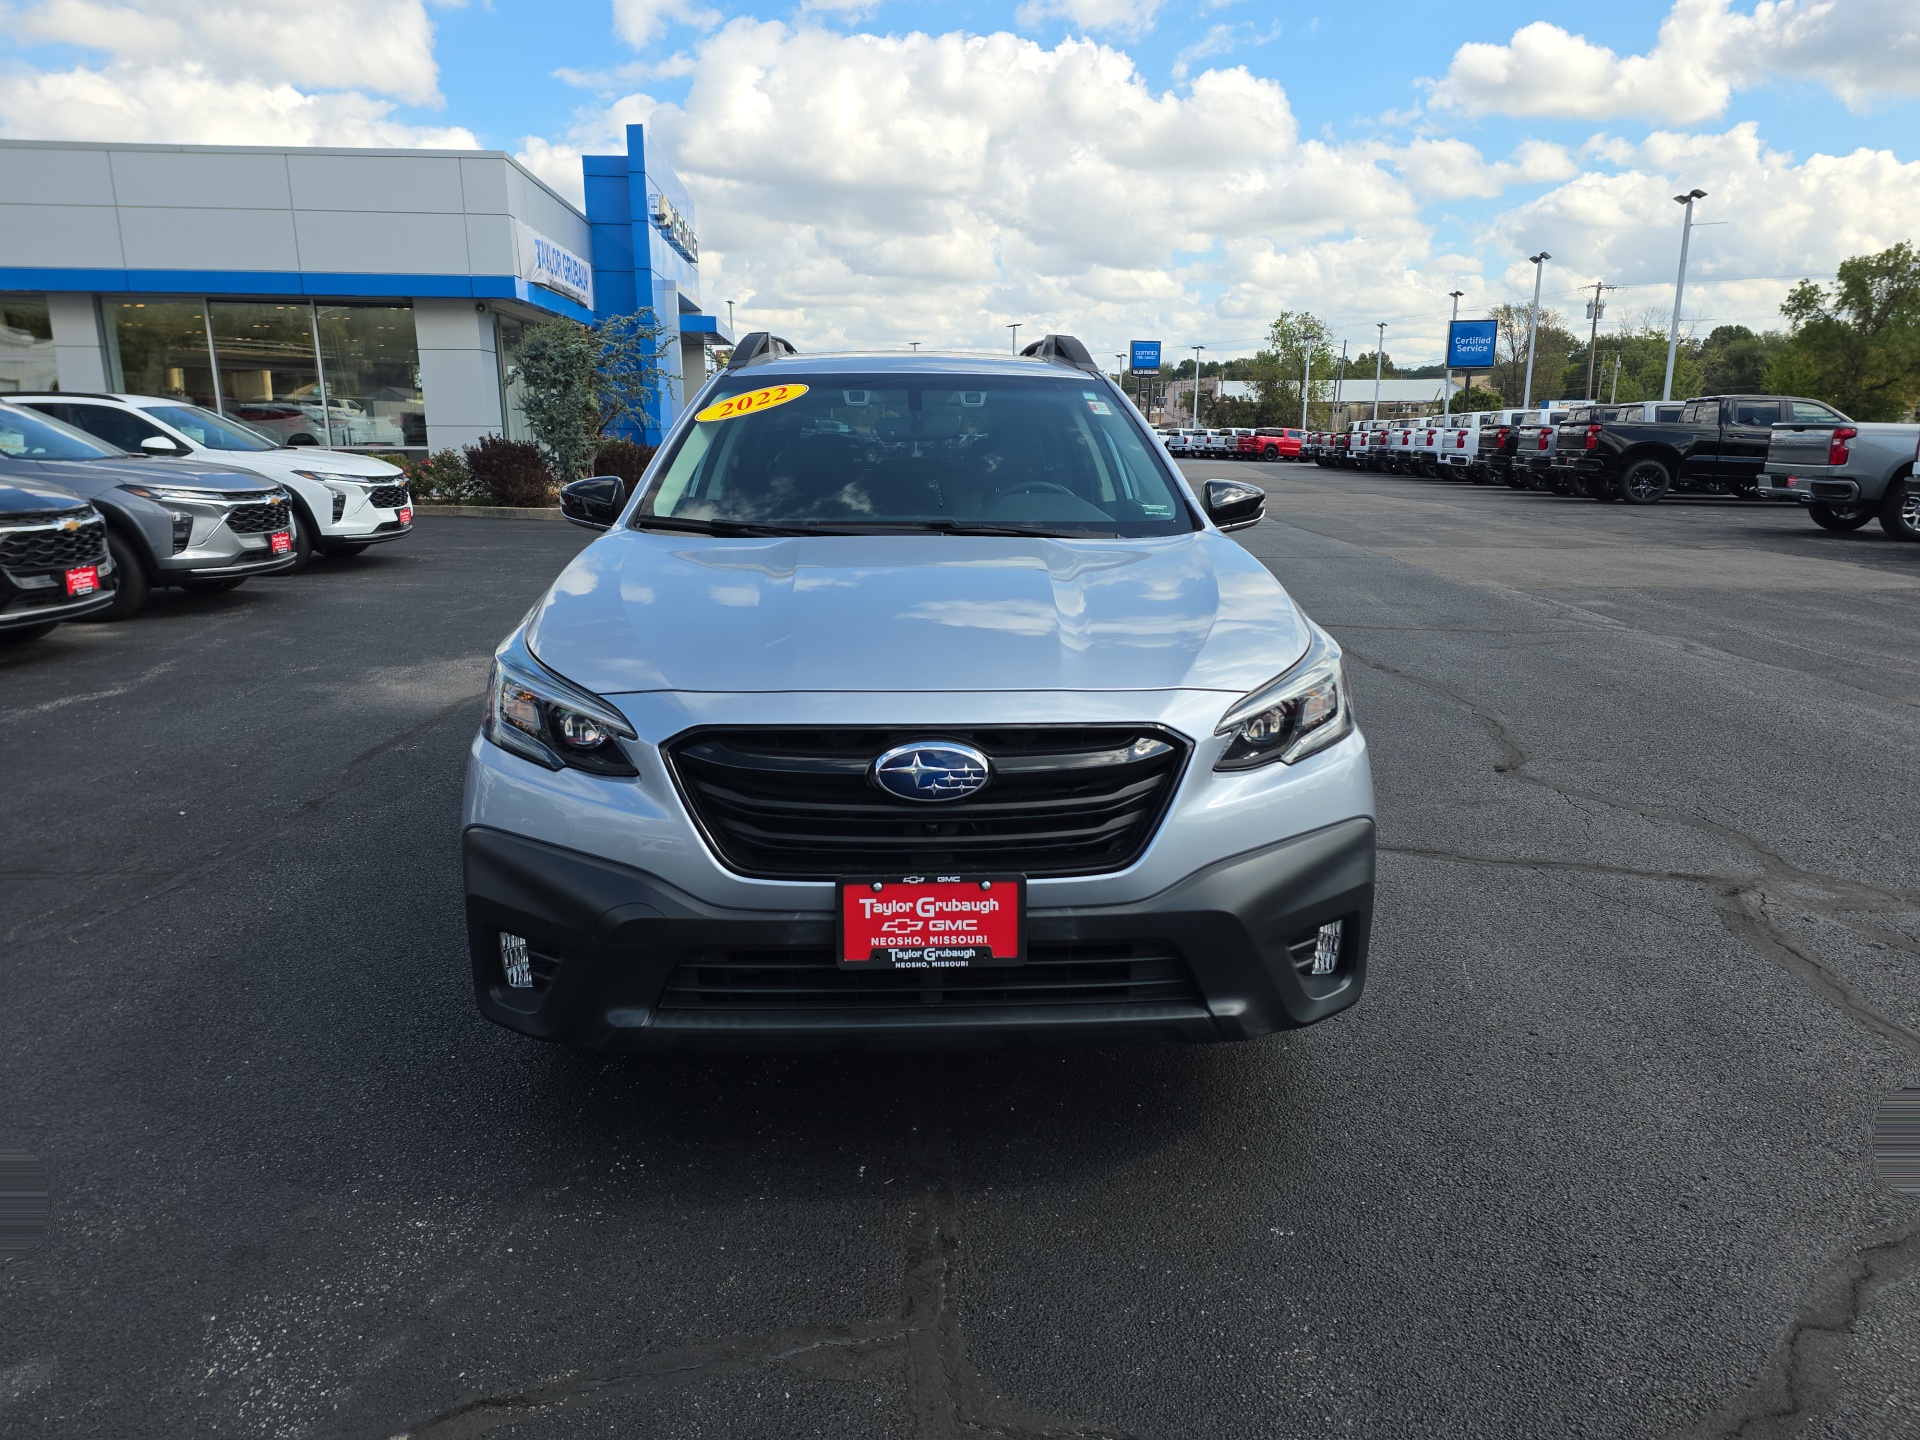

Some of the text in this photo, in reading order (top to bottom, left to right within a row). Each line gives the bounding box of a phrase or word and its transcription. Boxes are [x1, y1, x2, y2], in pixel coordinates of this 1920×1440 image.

[534, 239, 563, 279] TAYLOR
[1455, 336, 1491, 344] Certified
[719, 387, 788, 418] 2022
[858, 897, 999, 919] Taylor Grubaugh
[928, 919, 978, 931] GMC
[870, 935, 988, 947] NEOSHO, MISSOURI
[887, 947, 976, 962] Taylor Grubaugh
[931, 960, 969, 968] MISSOURI
